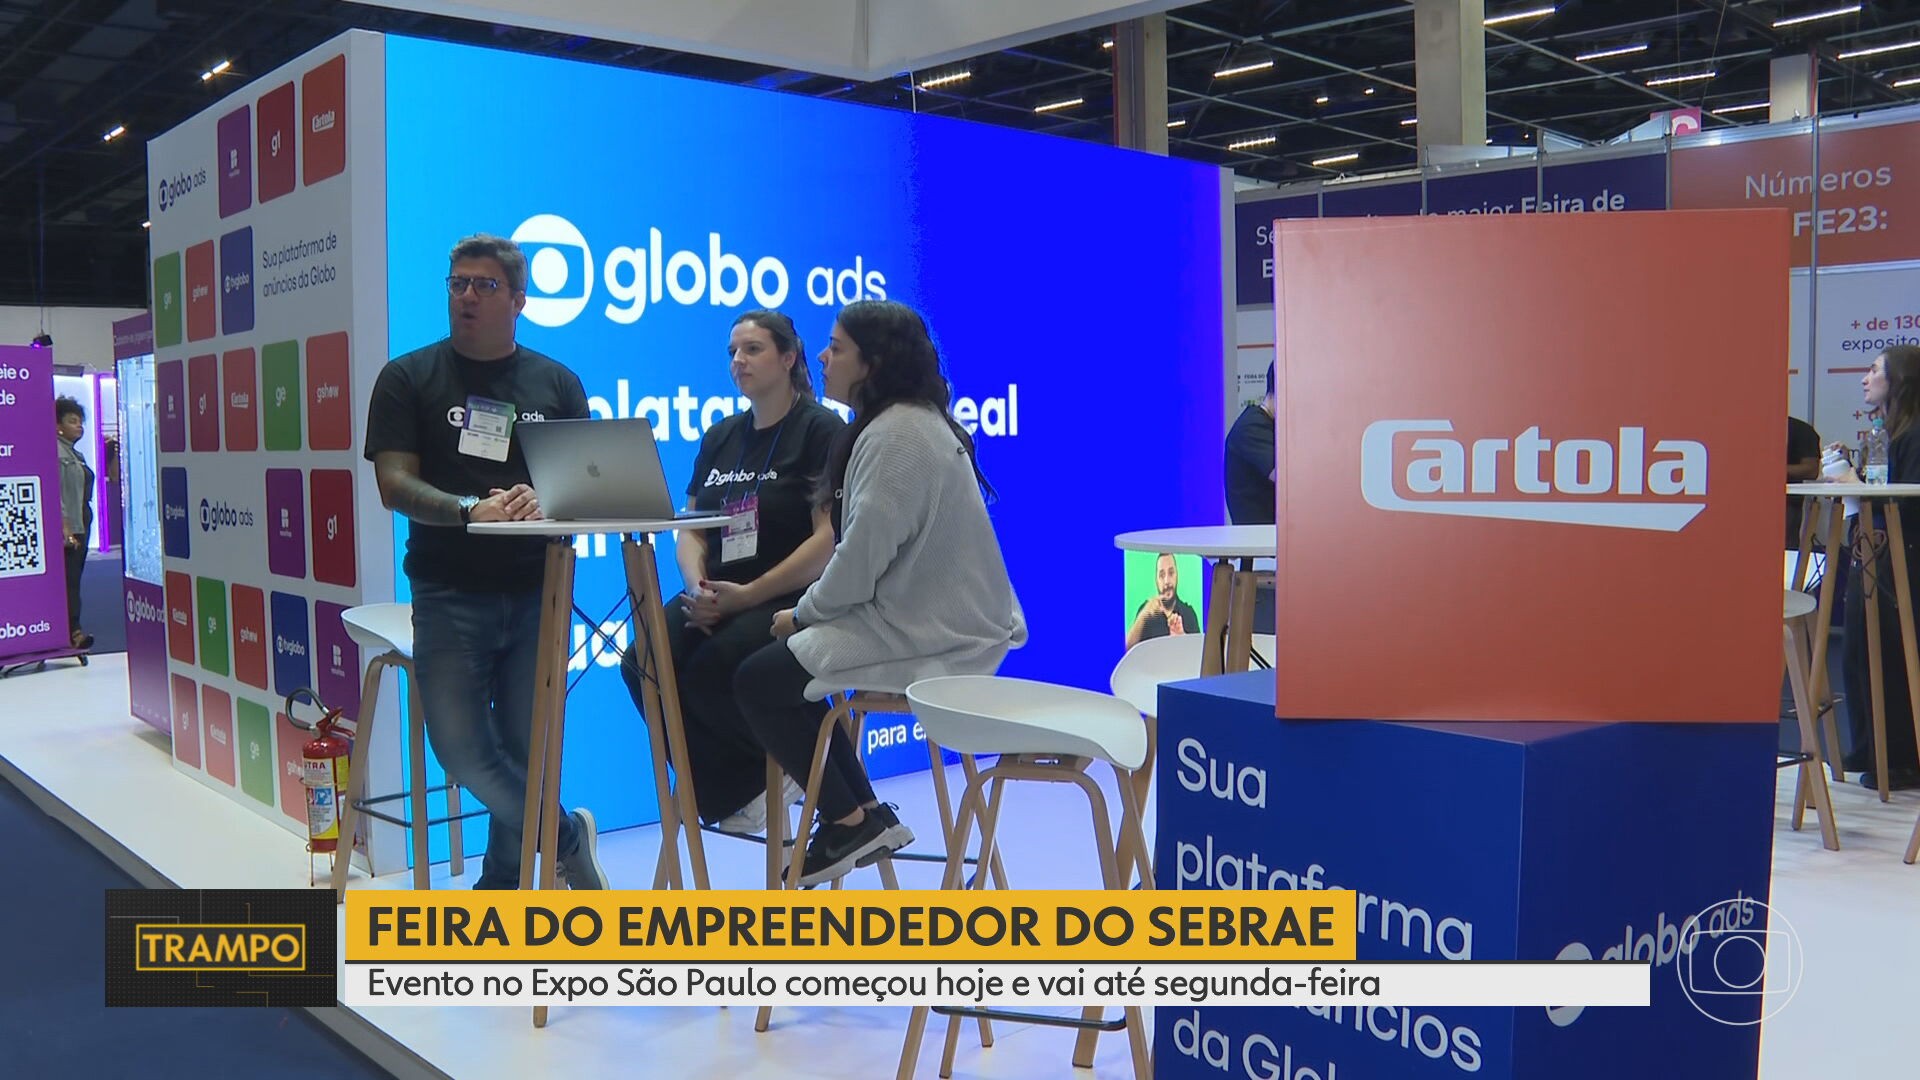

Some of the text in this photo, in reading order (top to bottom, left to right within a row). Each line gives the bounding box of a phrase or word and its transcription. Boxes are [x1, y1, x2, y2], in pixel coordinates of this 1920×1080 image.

[271, 130, 281, 157] g1
[168, 168, 206, 207] globo ads
[1745, 166, 1892, 200] Números
[1521, 194, 1584, 216] Feira
[1592, 188, 1626, 212] de
[1793, 205, 1888, 237] FE23:
[262, 230, 337, 270] Sua plataforma de
[263, 263, 336, 297] anúncios da Globo
[604, 226, 887, 325] globo ads
[1866, 317, 1889, 332] de
[275, 384, 287, 407] ge
[316, 382, 340, 404] gshow
[521, 410, 545, 422] ads
[717, 468, 755, 487] globo
[1361, 418, 1708, 532] Cartola
[210, 501, 254, 532] globo ads
[327, 514, 338, 541] g1
[134, 596, 156, 624] globo
[29, 620, 51, 634] ads
[867, 721, 907, 755] para
[1175, 736, 1268, 810] Sua
[1708, 889, 1756, 940] ads
[1173, 1009, 1230, 1072] da
